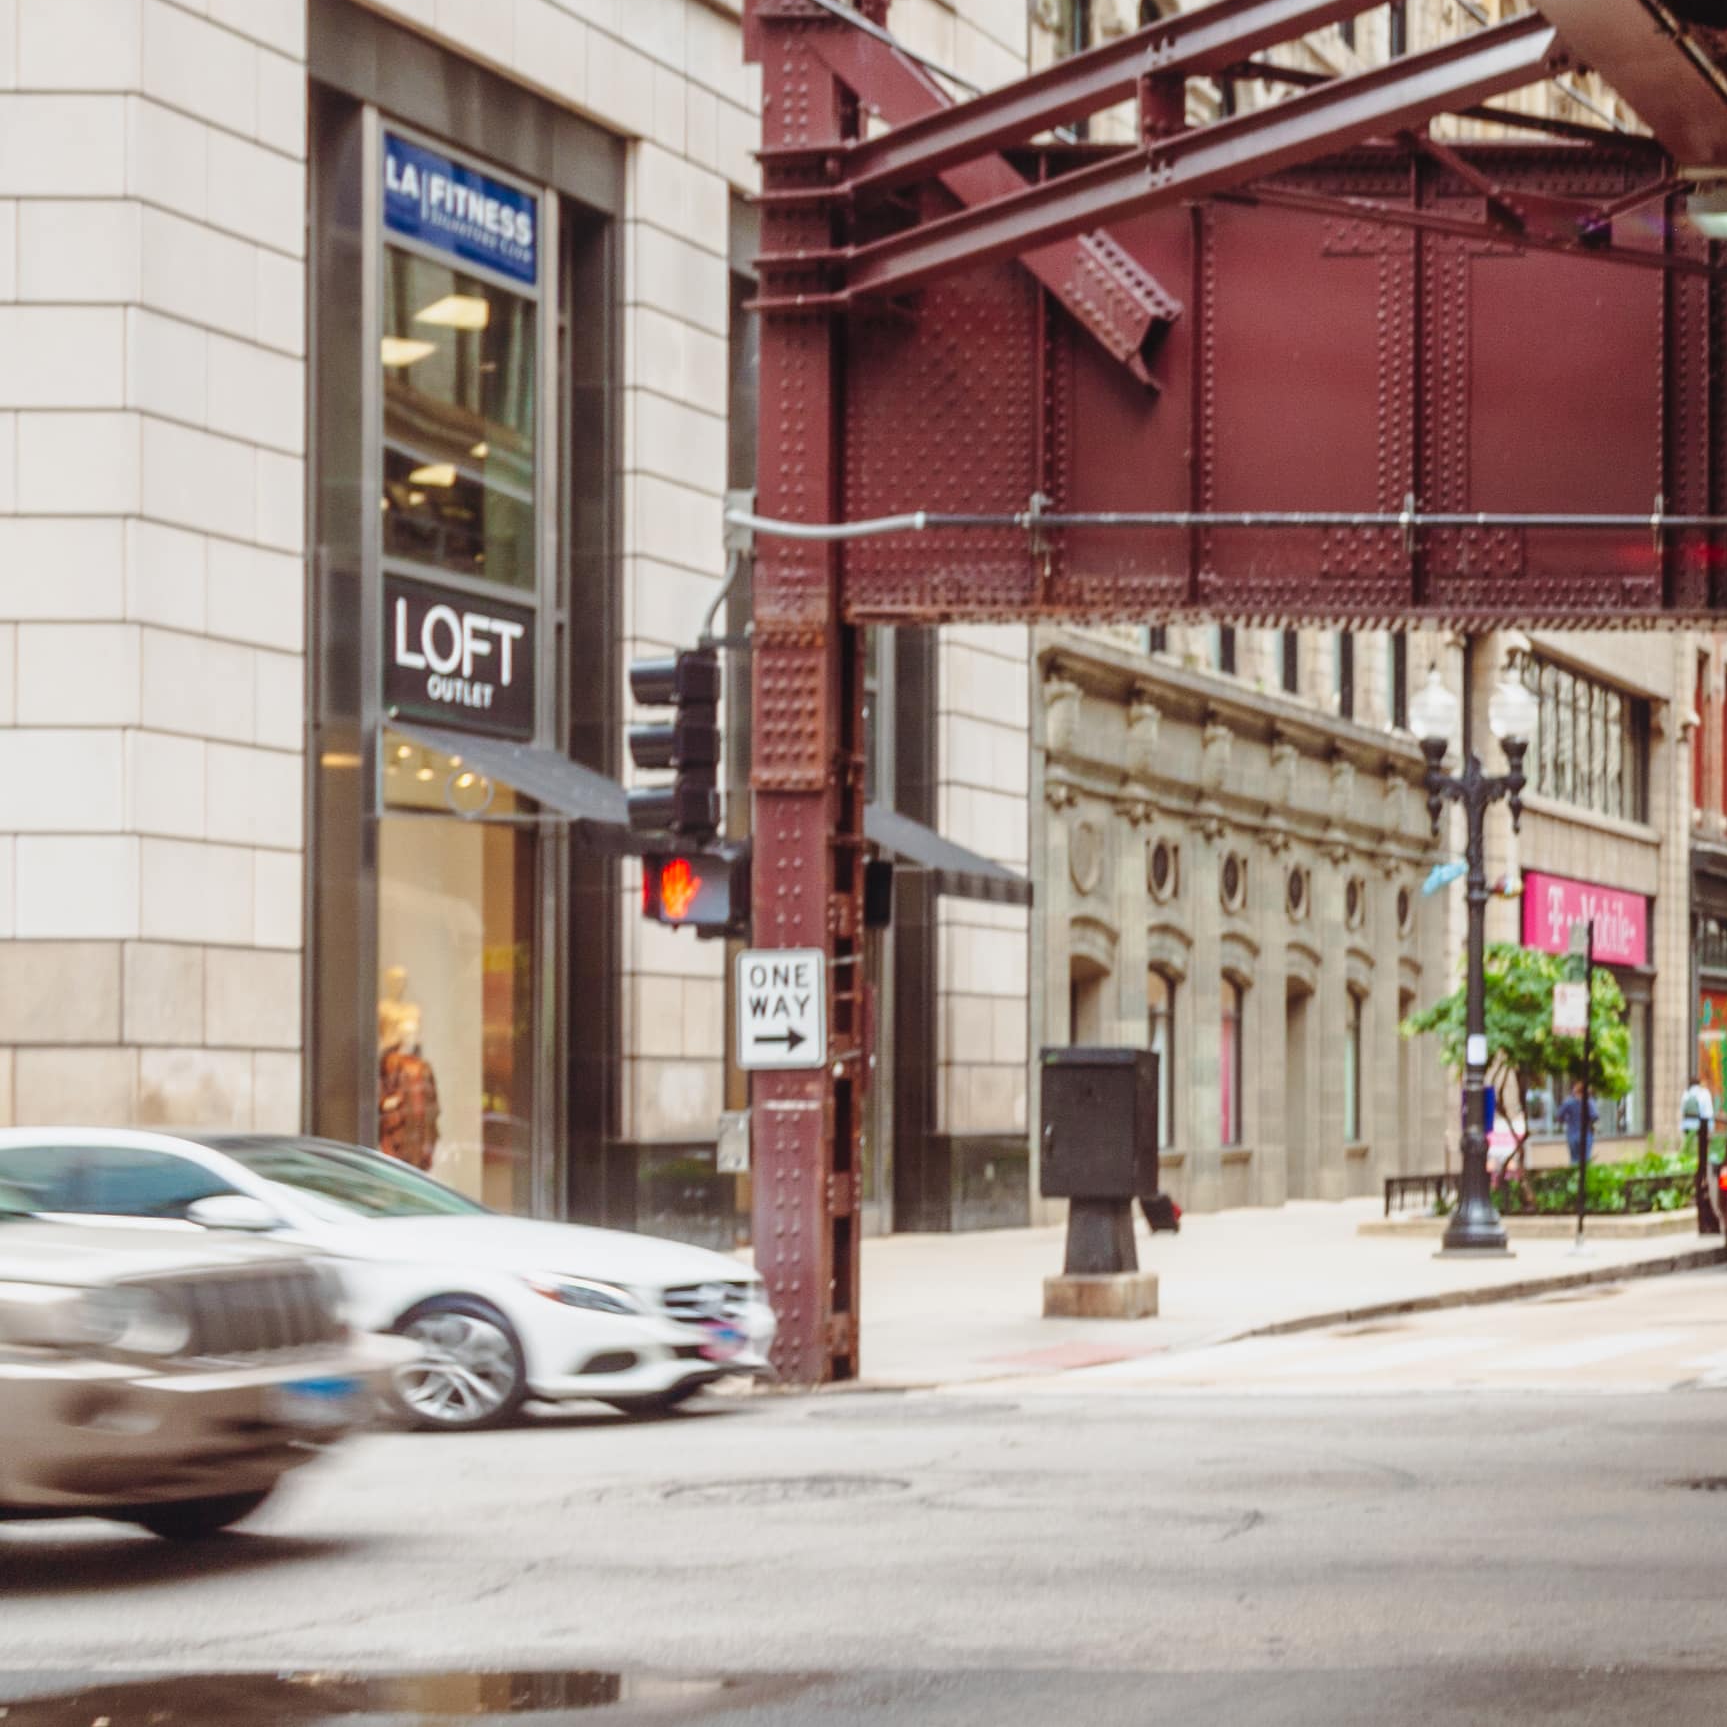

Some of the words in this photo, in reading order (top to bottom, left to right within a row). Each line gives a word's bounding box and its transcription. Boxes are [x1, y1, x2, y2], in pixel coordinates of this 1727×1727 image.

[386, 154, 419, 201] LA
[429, 173, 532, 247] FITNESS
[396, 596, 525, 687] LOFT
[427, 673, 495, 709] OUTLET
[750, 963, 810, 989] ONE
[749, 994, 812, 1019] WAY
